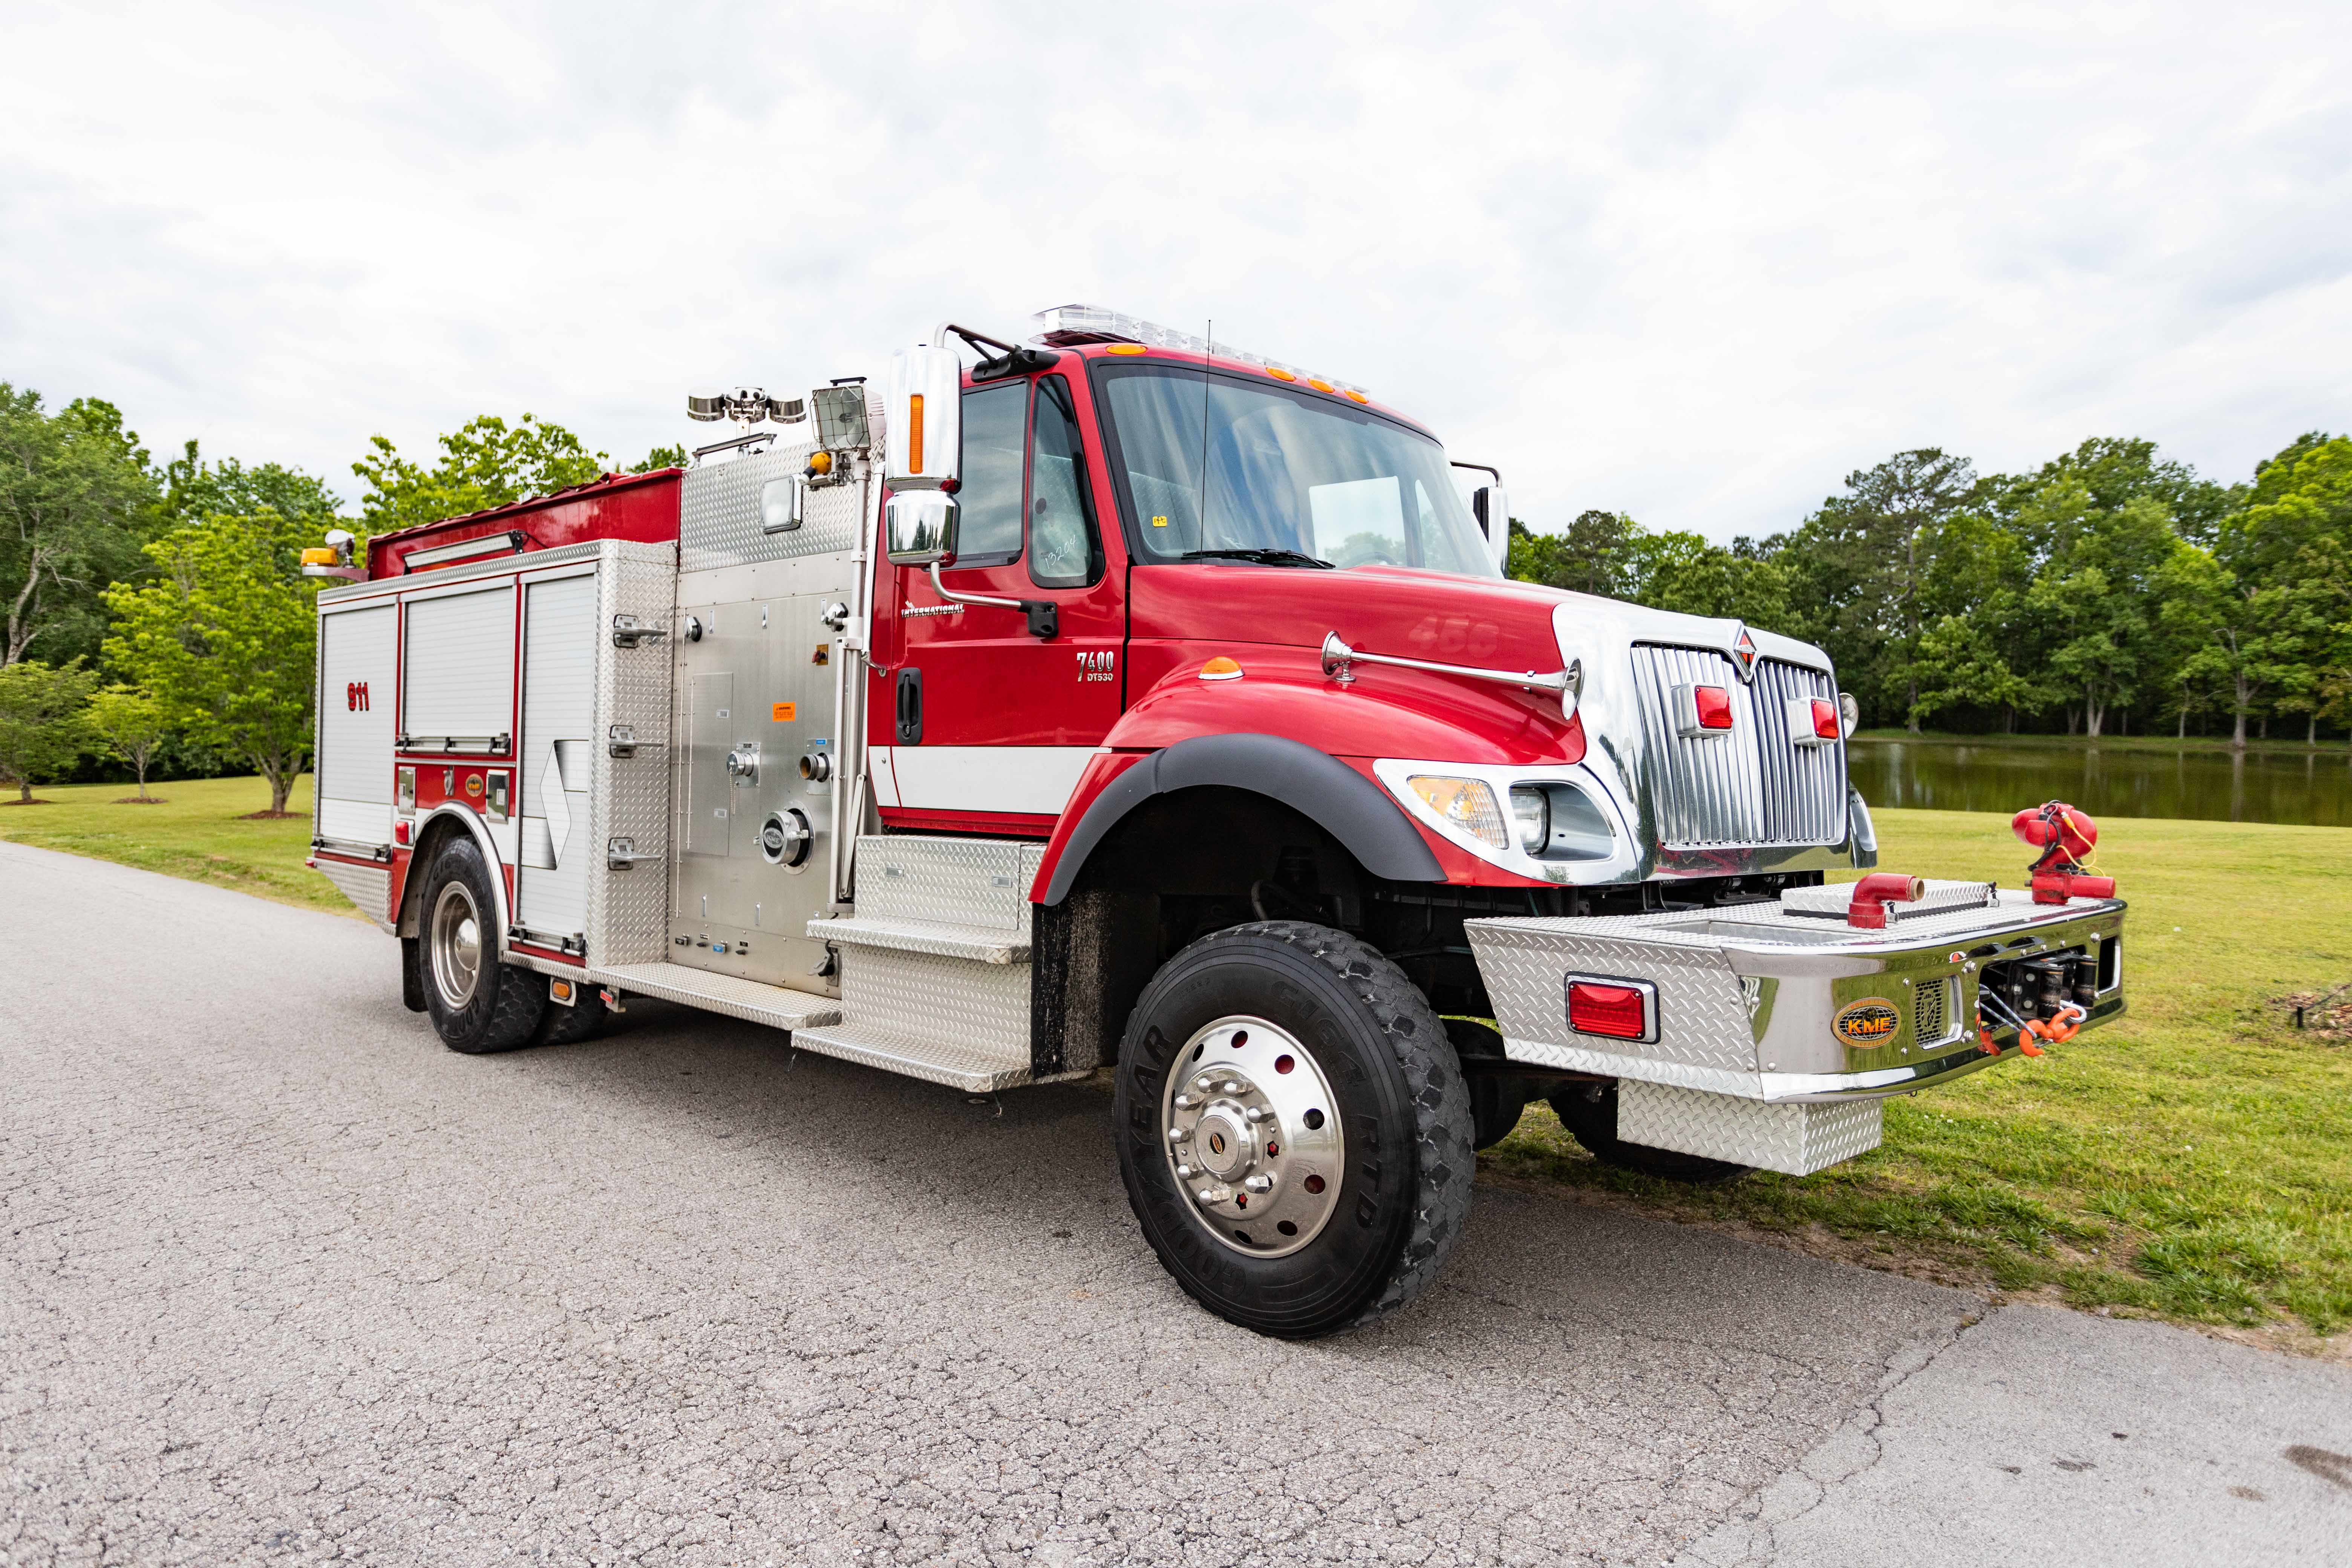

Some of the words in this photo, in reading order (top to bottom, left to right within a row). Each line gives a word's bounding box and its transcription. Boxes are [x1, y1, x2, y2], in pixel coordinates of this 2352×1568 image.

[1045, 534, 1076, 570] 13204
[900, 603, 965, 618] INTERNATIONAL
[1076, 651, 1114, 682] 7400
[1087, 673, 1113, 682] DT530
[347, 681, 369, 712] 911
[1271, 980, 1366, 1087] G164
[1848, 1017, 1891, 1034] KME
[1129, 1024, 1248, 1297] GOODYEAR
[1355, 1113, 1383, 1230] RTD
